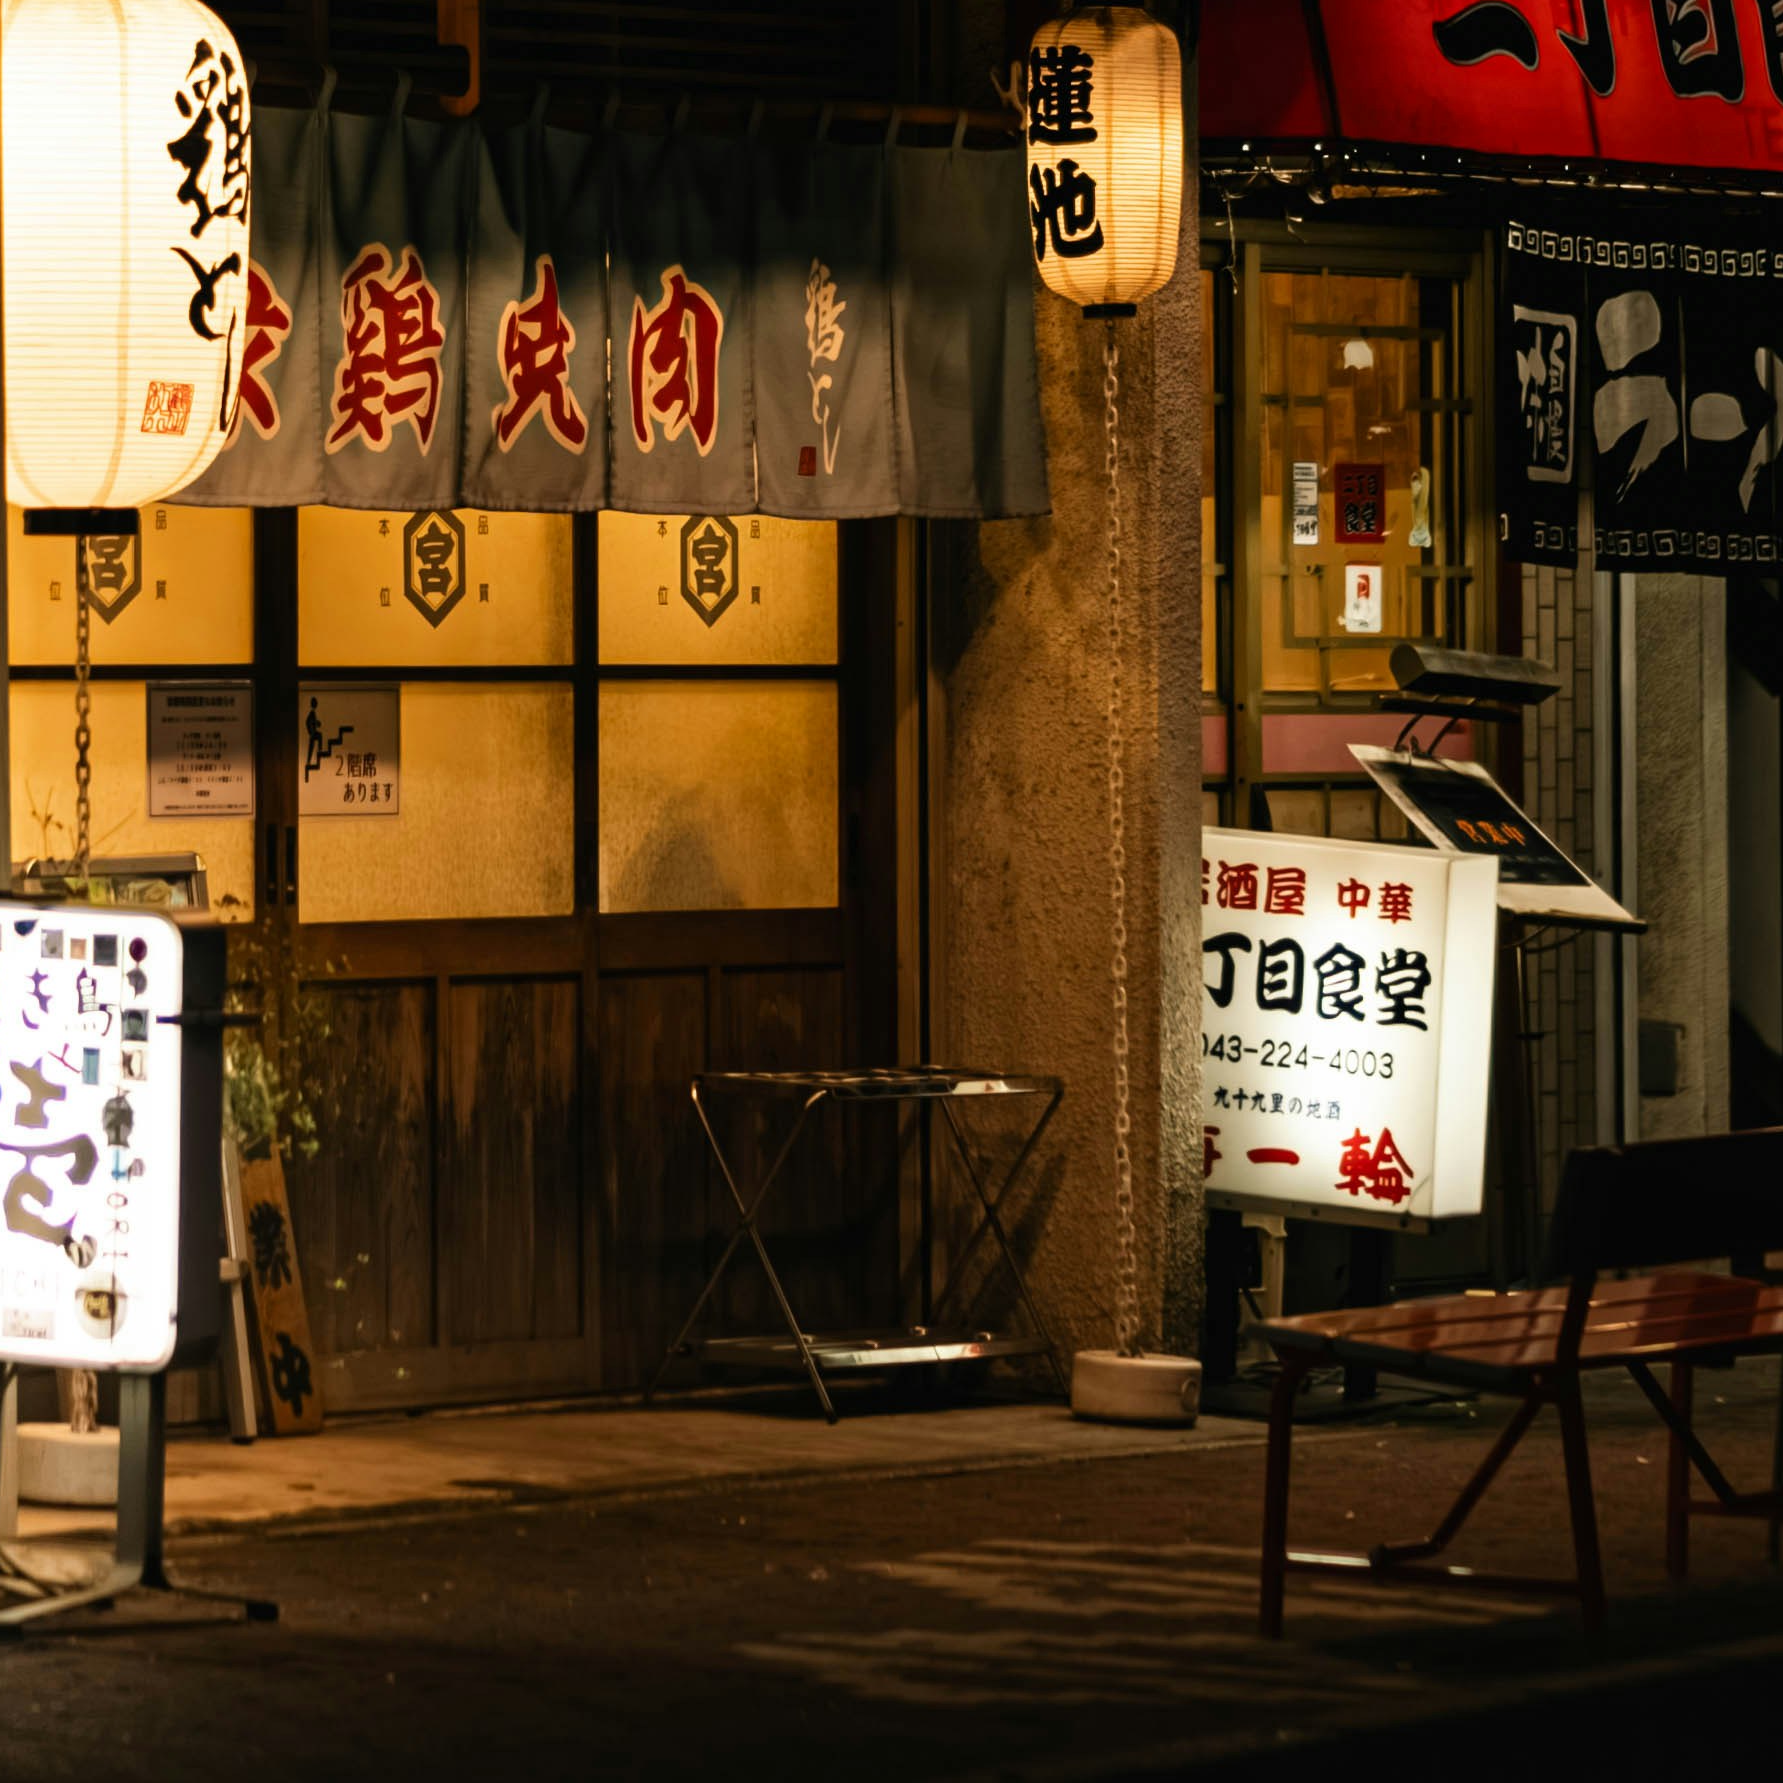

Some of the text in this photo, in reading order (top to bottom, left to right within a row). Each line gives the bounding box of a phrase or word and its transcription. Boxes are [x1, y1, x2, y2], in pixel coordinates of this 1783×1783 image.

[1028, 44, 1105, 263] 蓮池
[168, 37, 251, 433] 鶏とし
[415, 521, 456, 597] 宮
[692, 523, 729, 597] 宮
[335, 752, 378, 779] 2階席
[342, 781, 394, 804] あります
[1201, 859, 1414, 925] 酒屋 中華
[1214, 1085, 1342, 1121] 九十九里の地酒
